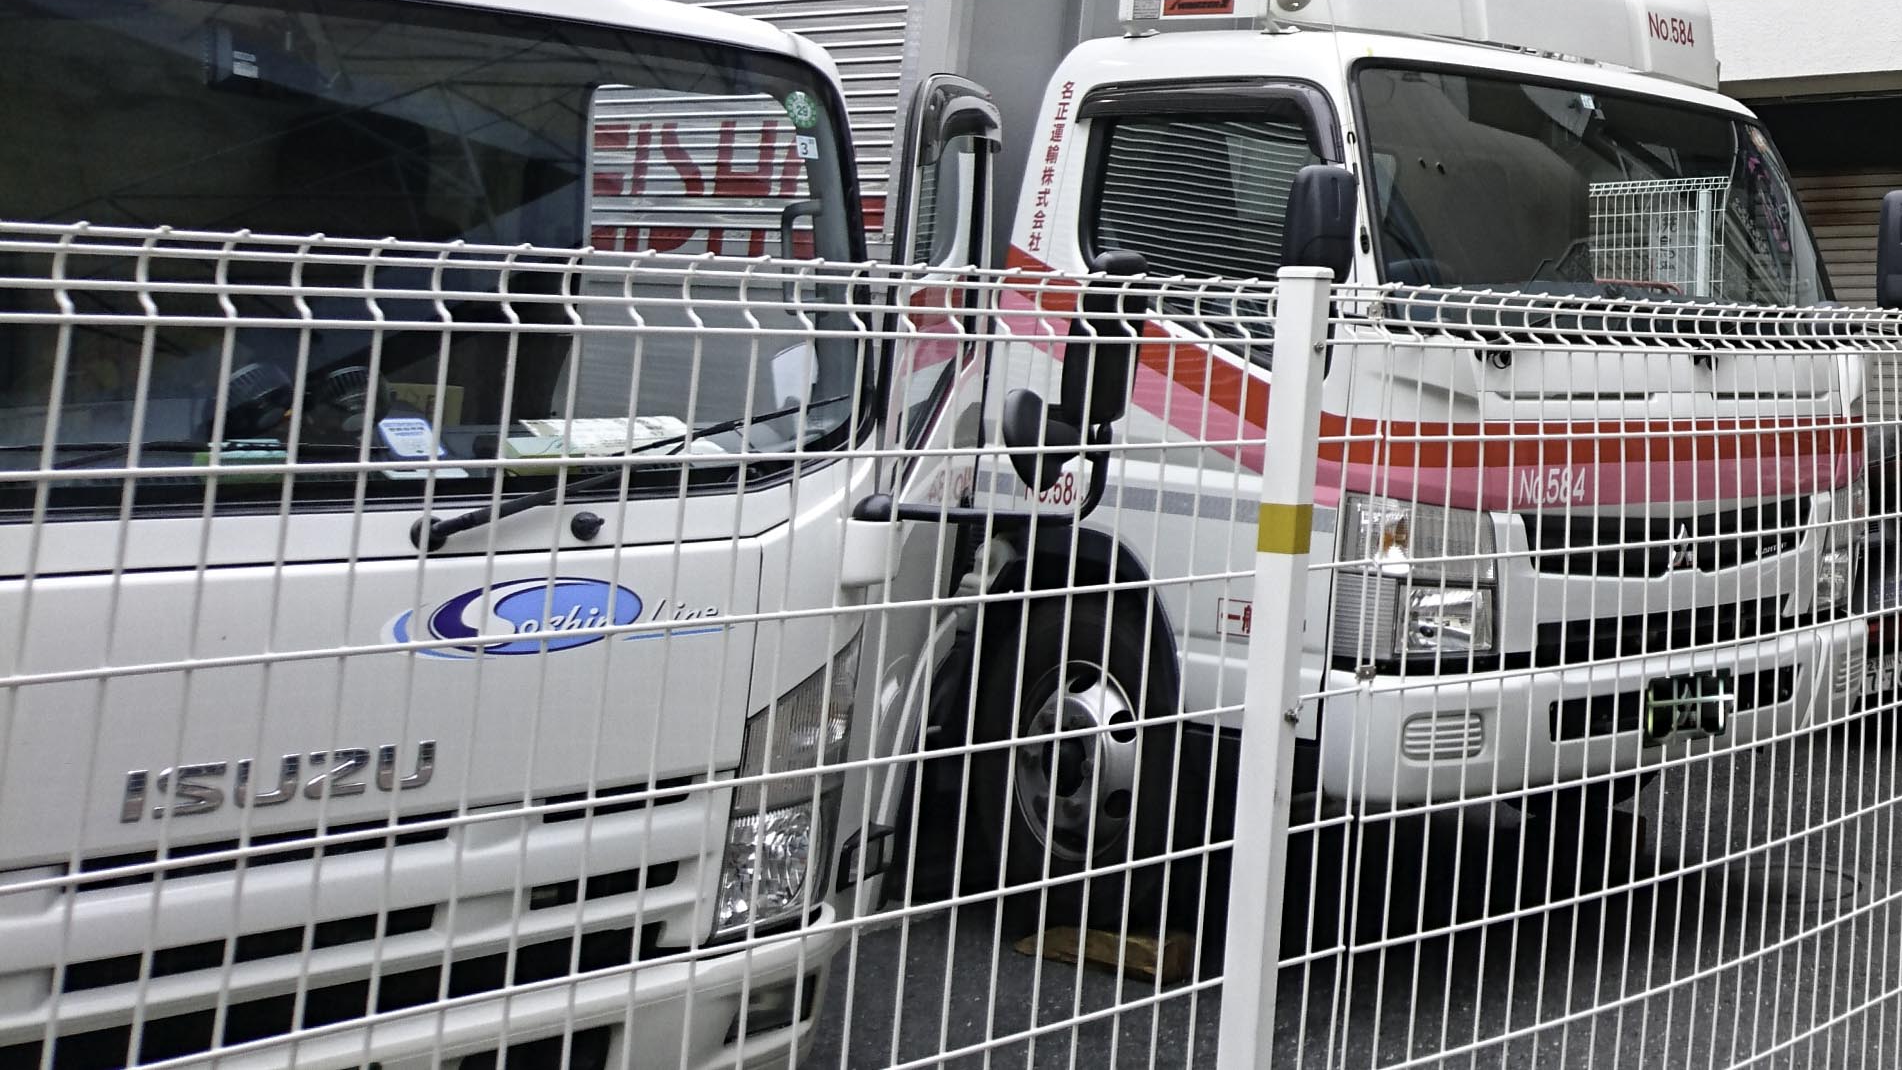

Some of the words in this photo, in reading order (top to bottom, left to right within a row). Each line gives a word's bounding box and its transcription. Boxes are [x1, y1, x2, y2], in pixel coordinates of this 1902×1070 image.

[1648, 11, 1694, 47] No.584
[1028, 81, 1075, 252] 名正運輸株式会社
[120, 740, 437, 824] ISUZU
